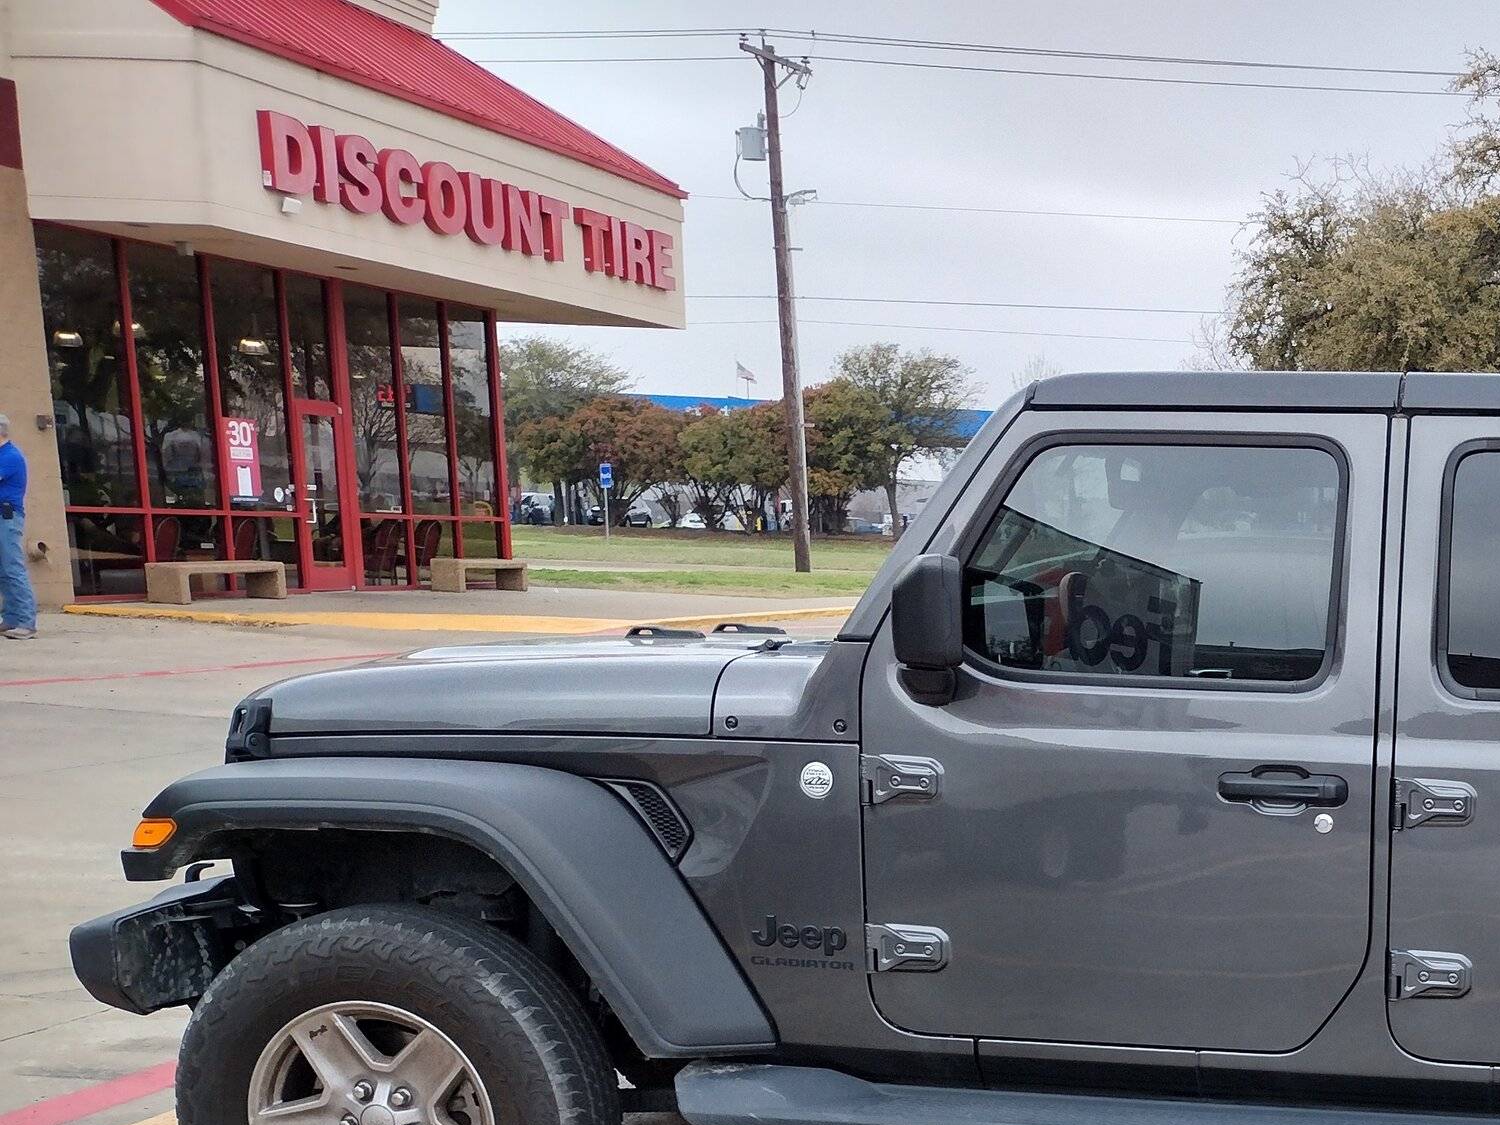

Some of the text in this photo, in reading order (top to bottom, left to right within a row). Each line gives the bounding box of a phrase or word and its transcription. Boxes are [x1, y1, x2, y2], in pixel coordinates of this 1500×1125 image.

[257, 110, 677, 291] DISCOUNT TIRE
[751, 914, 848, 956] Jeep
[750, 955, 855, 971] GLADIATOR
